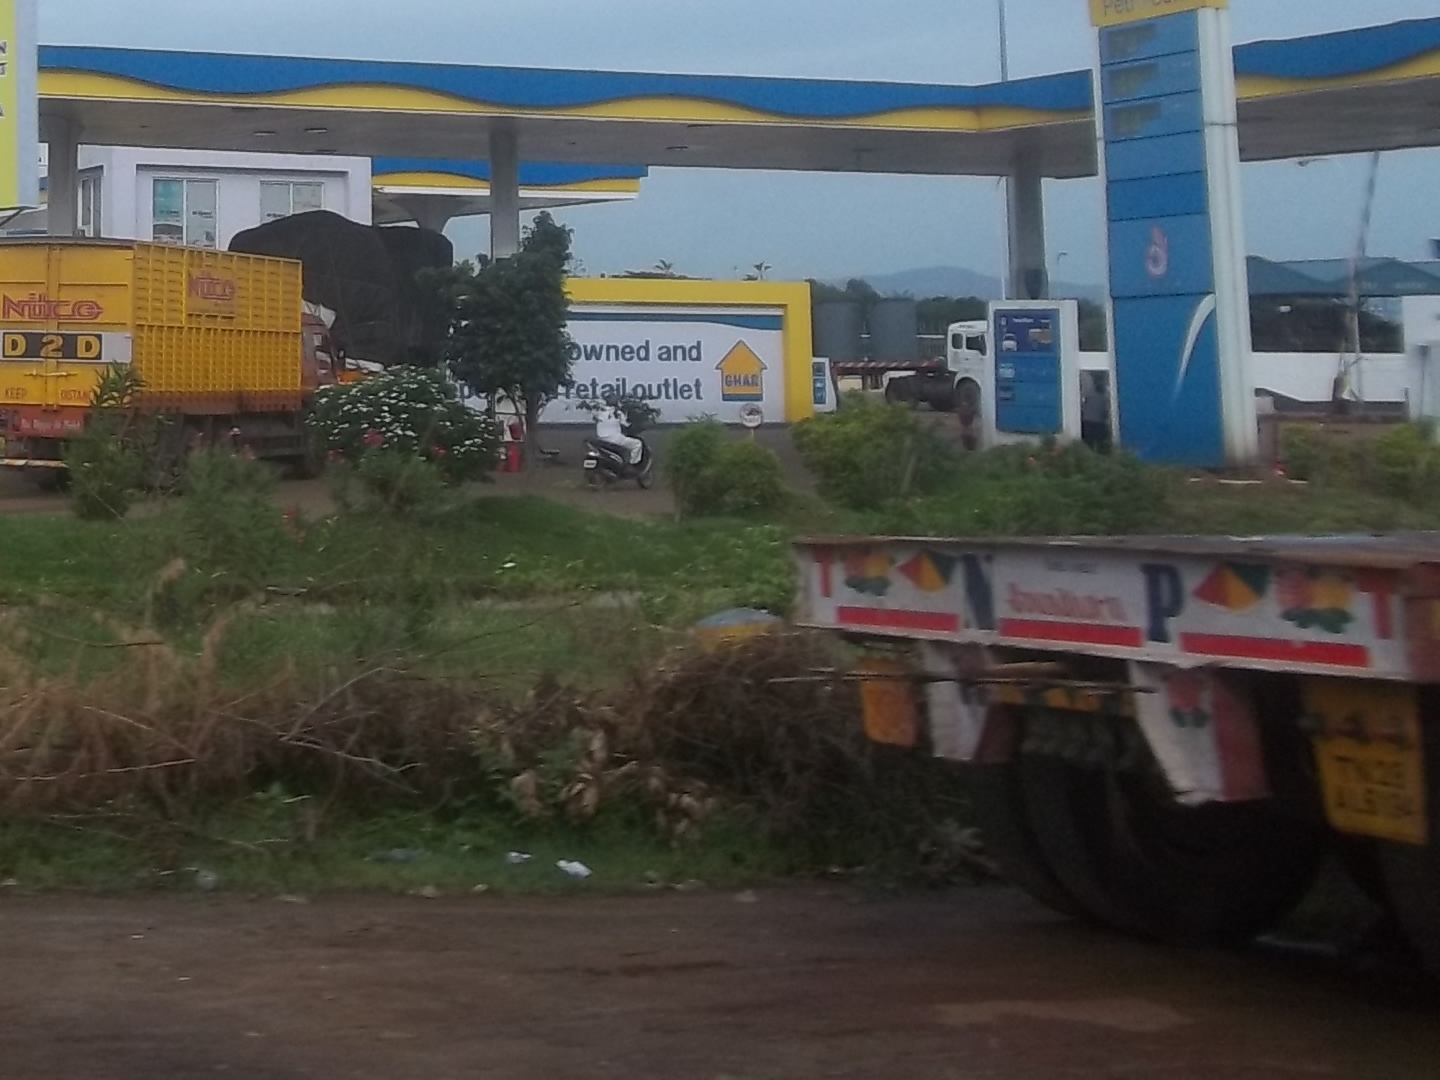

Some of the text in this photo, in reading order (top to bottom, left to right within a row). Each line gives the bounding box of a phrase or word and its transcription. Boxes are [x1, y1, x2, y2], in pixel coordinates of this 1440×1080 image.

[567, 339, 703, 362] owned and
[565, 377, 704, 400] retail outlet
